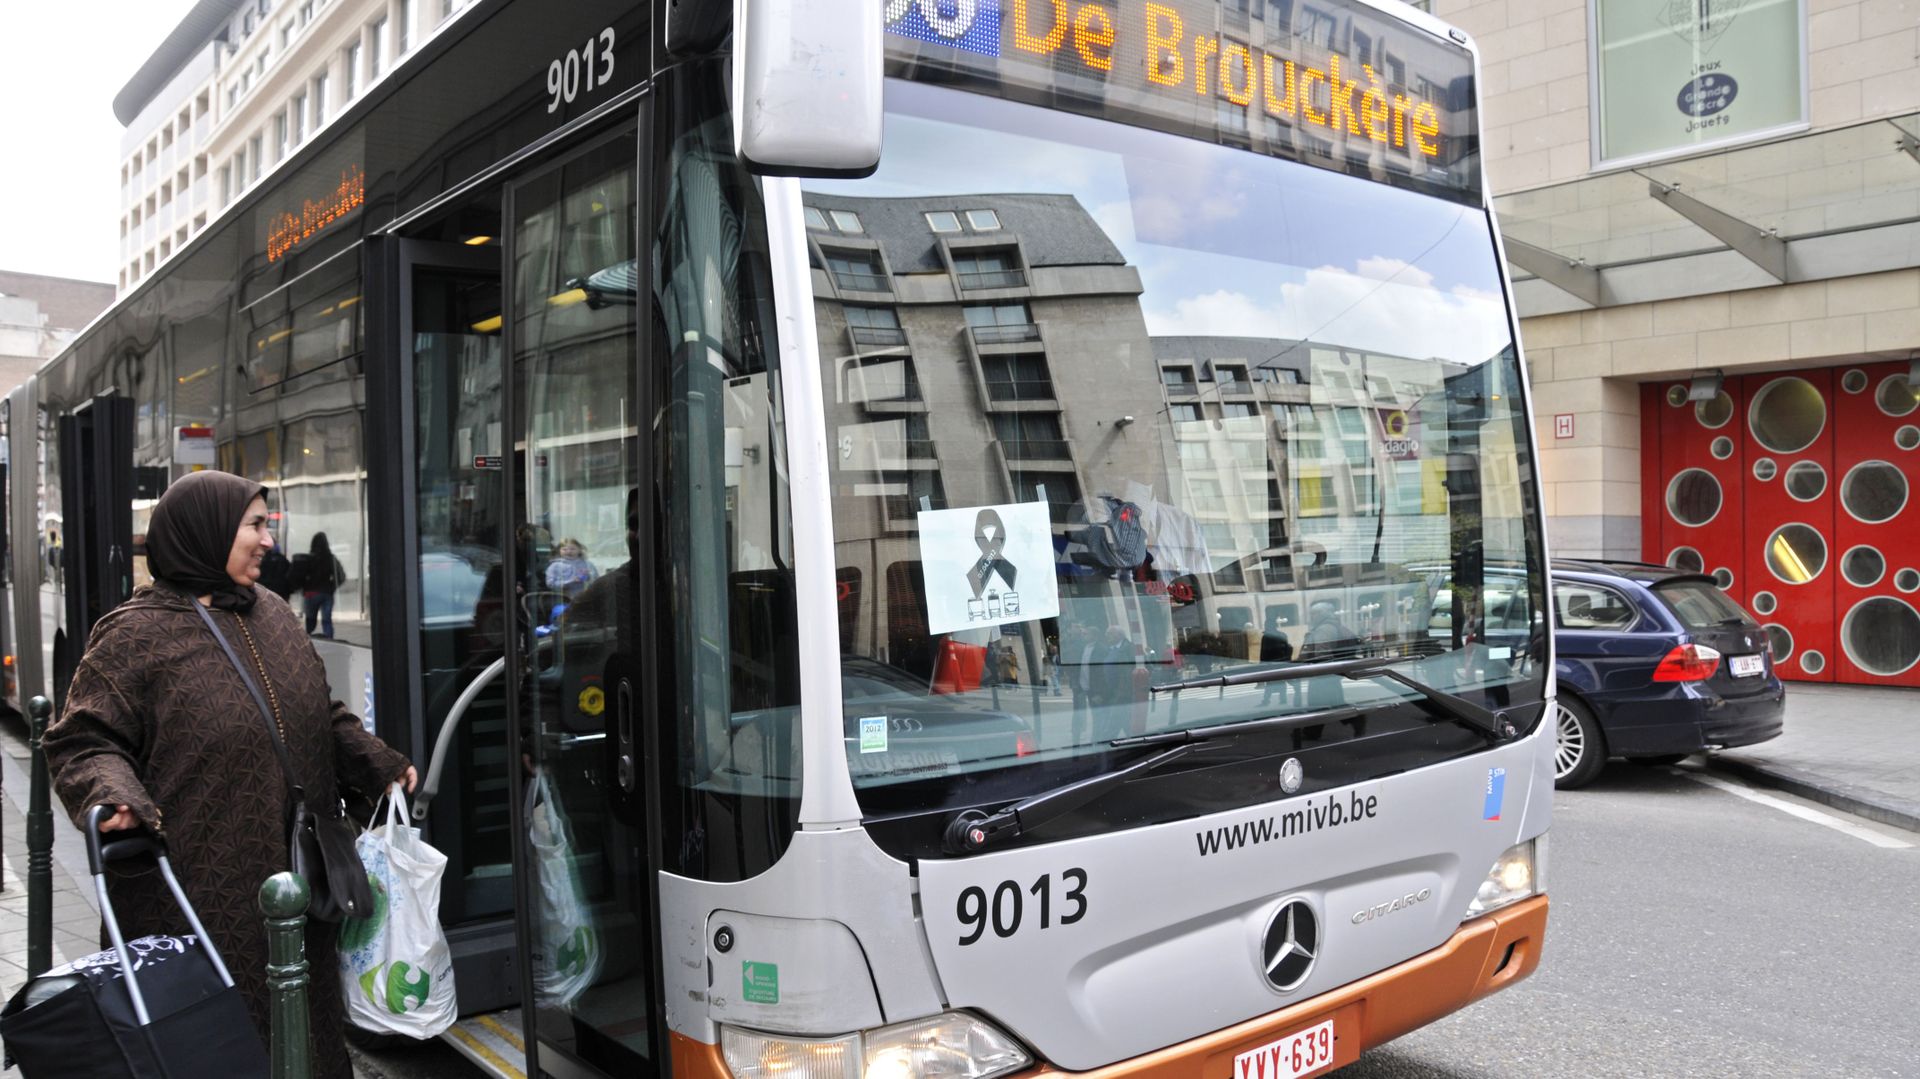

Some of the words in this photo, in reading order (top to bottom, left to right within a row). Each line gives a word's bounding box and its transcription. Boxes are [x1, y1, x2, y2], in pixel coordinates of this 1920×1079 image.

[547, 26, 615, 114] 9013
[1014, 0, 1115, 70] De
[1146, 2, 1439, 156] Brouckère
[1691, 61, 1721, 76] Jeux
[1686, 115, 1730, 133] Jouets
[1559, 418, 1570, 434] H
[1378, 437, 1419, 457] adagio
[865, 724, 882, 734] 2012
[1196, 790, 1378, 857] www.mivb.be
[956, 867, 1088, 946] 9013
[1352, 887, 1432, 924] CITARO
